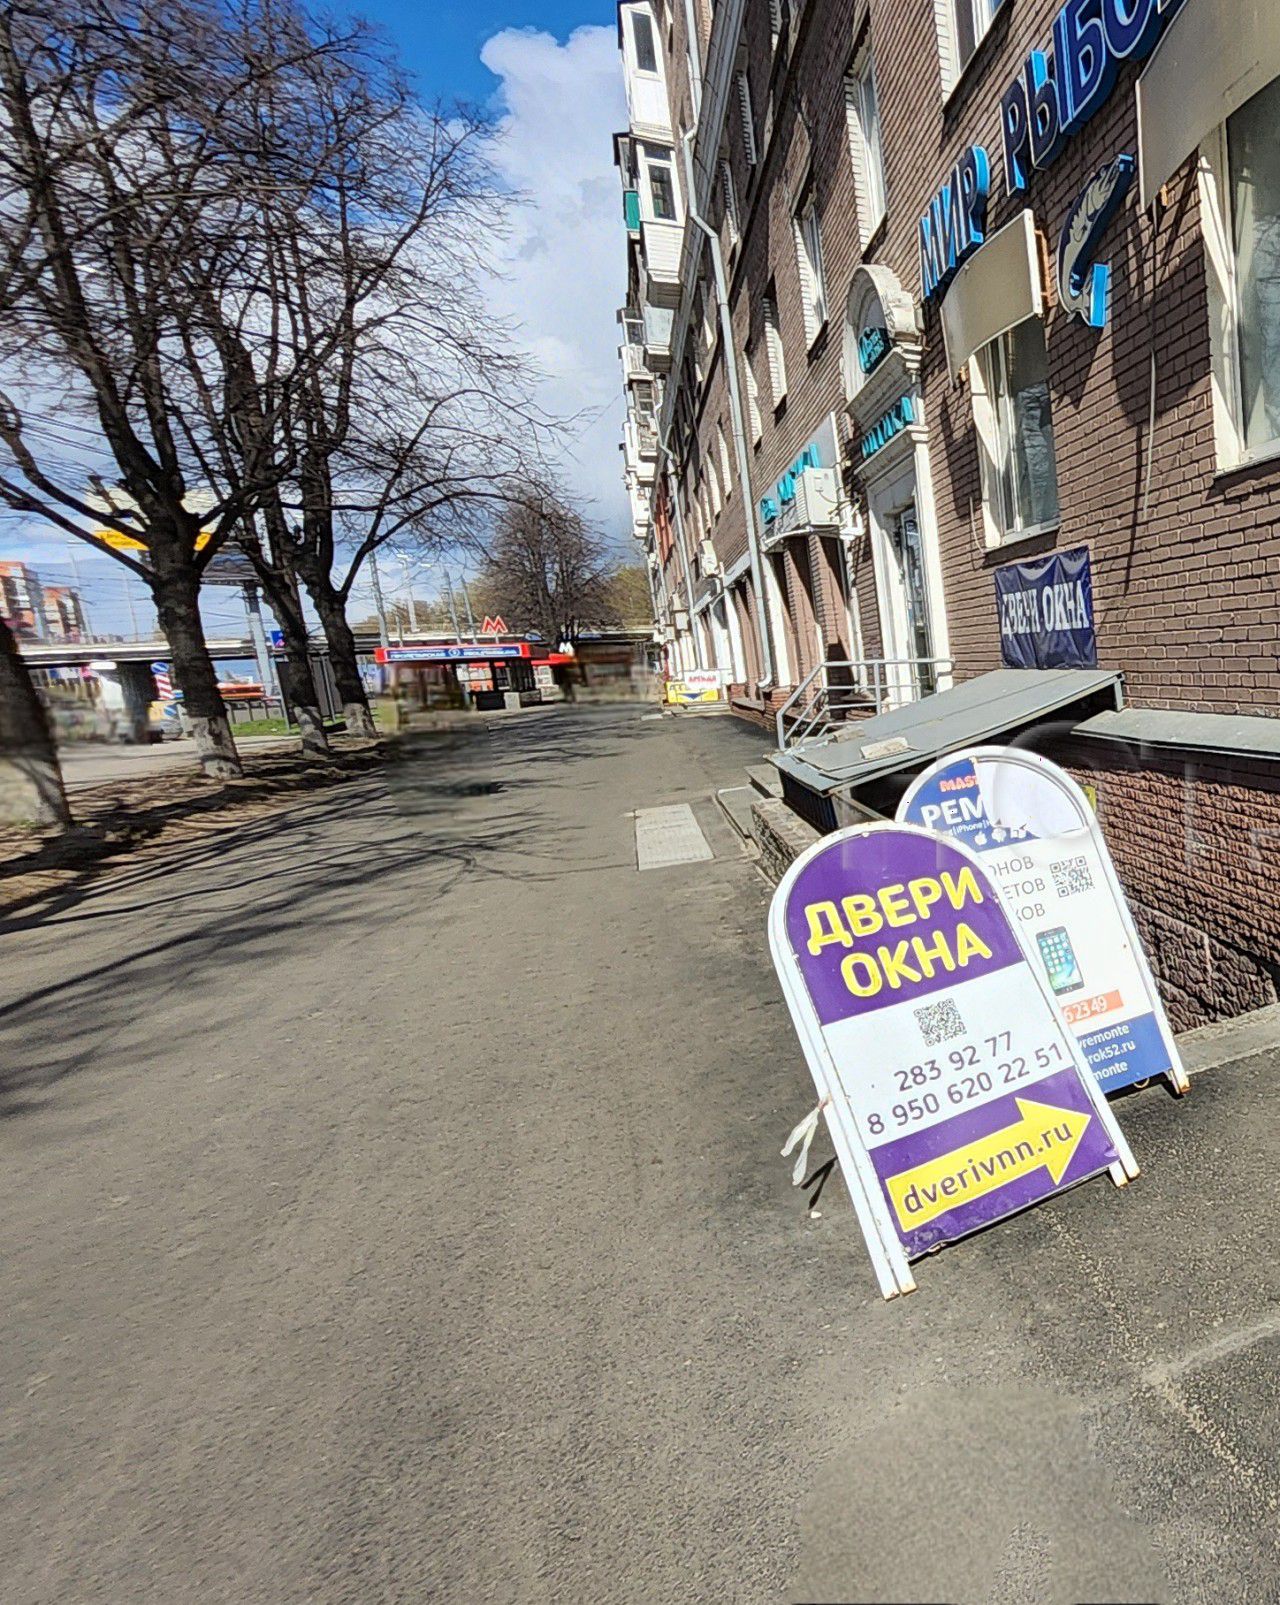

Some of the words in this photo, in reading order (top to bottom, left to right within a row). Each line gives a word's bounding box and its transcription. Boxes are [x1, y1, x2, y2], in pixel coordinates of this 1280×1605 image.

[918, 145, 991, 301] МИР
[1000, 0, 1168, 197] РЫБО
[1042, 580, 1090, 633] ОКНА
[805, 866, 984, 956] ДВЕРИ
[840, 930, 993, 998] ОКНА
[867, 1112, 885, 1135] 8
[892, 1093, 940, 1127] 950
[947, 1071, 993, 1105] 620
[998, 1056, 1030, 1084] 22
[1034, 1042, 1063, 1069] 51
[894, 1059, 942, 1092] 283
[948, 1045, 980, 1071] 92
[984, 1030, 1012, 1058] 77
[903, 1122, 1073, 1214] dverivnn.ru
